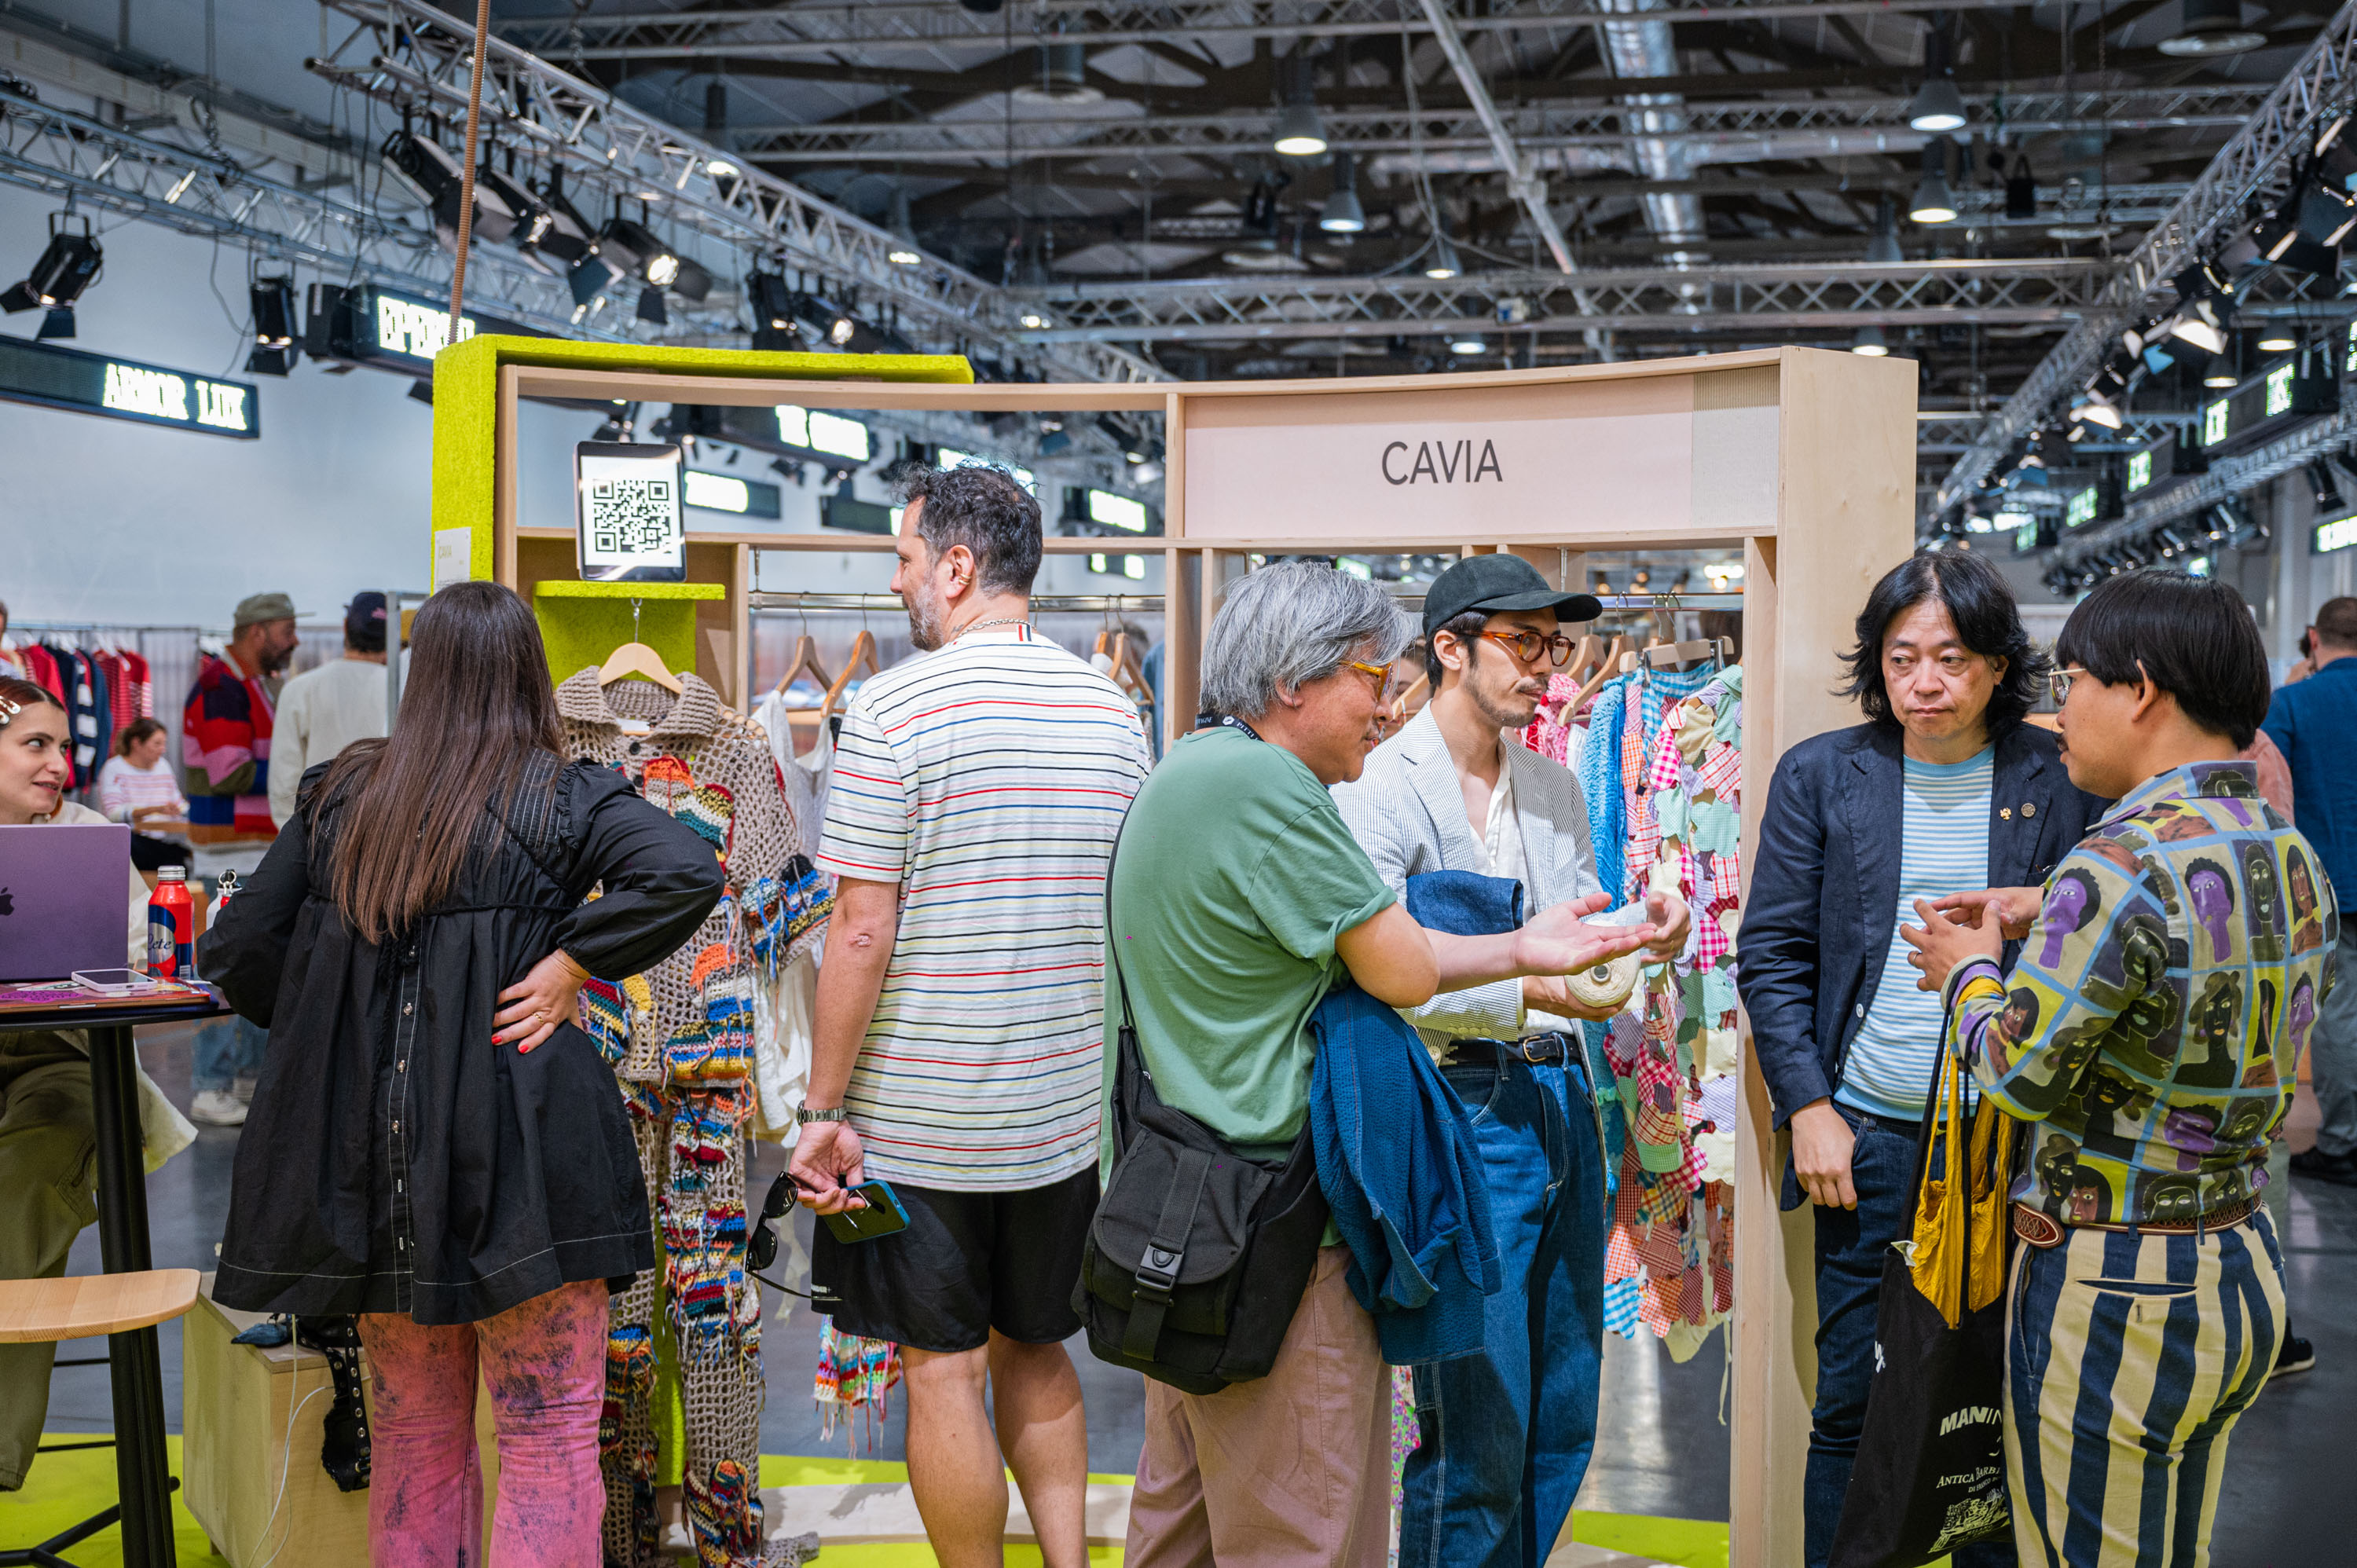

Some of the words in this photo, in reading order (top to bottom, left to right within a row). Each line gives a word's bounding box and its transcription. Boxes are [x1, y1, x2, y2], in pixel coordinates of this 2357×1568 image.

[102, 363, 189, 420] ARMOR
[195, 379, 247, 430] LUX
[1382, 439, 1503, 485] CAVIA
[1237, 722, 1255, 738] PITTI
[1936, 1473, 1974, 1489] ANTICA
